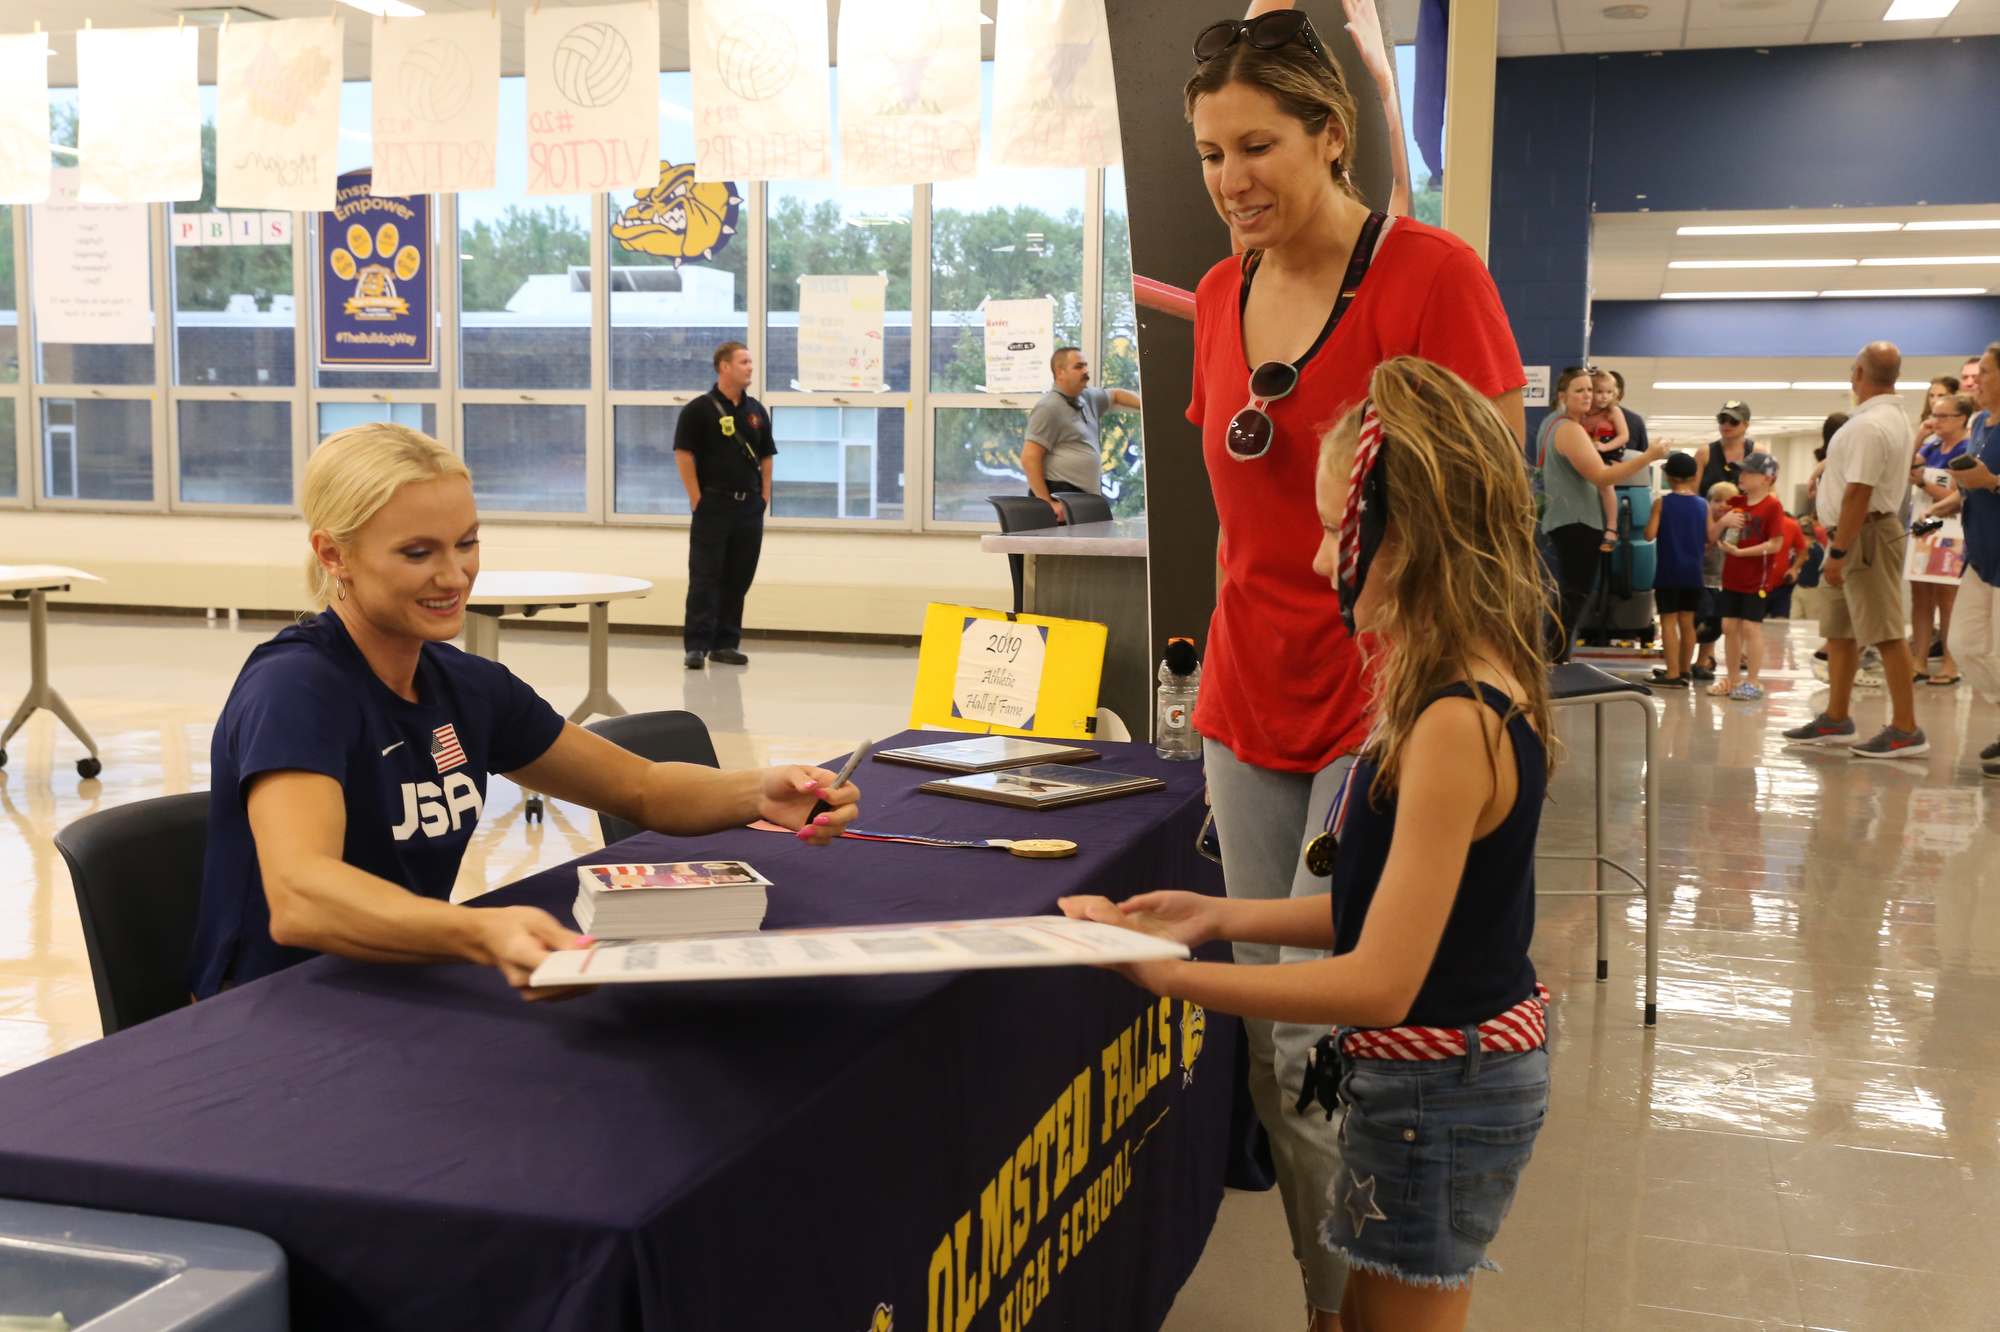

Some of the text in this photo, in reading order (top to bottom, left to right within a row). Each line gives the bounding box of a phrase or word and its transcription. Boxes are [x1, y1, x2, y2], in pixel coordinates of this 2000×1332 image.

[333, 197, 416, 222] Empower
[335, 331, 417, 347] #TheBulldogWay
[986, 634, 1022, 663] 2019
[981, 668, 1016, 688] Athletic
[966, 693, 1024, 717] Hall of Fame
[1164, 704, 1186, 729] G
[927, 996, 1171, 1332] OLMSTED FALLS
[999, 1138, 1131, 1332] HIGH SCHOOL
